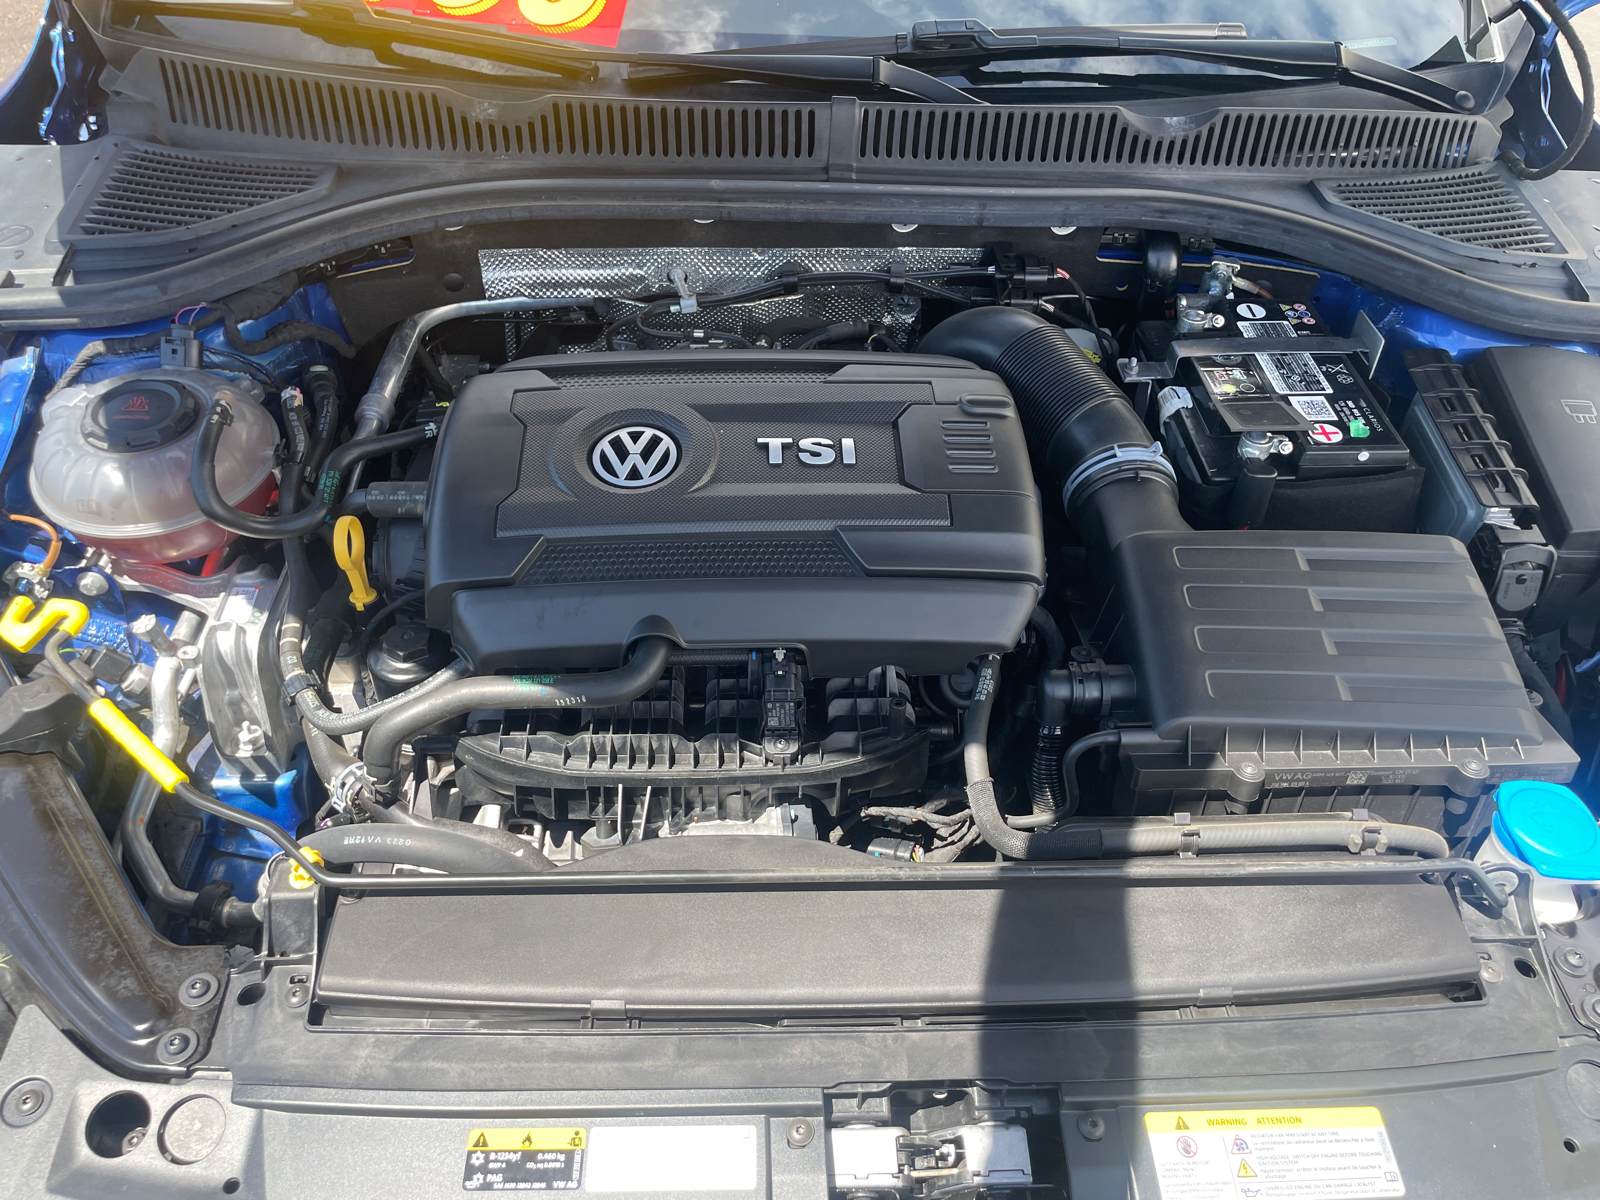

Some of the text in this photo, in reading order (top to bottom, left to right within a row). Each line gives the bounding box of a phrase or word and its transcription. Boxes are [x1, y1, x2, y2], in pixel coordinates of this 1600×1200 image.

[1363, 407, 1384, 432] CLARIOS
[592, 426, 677, 487] VW
[756, 437, 856, 465] TSI
[1294, 772, 1312, 780] AG
[386, 838, 412, 846] 0223
[1206, 1116, 1302, 1127] WARNING ATTENTION
[490, 1152, 522, 1162] R-1234yf
[557, 1152, 566, 1162] kg
